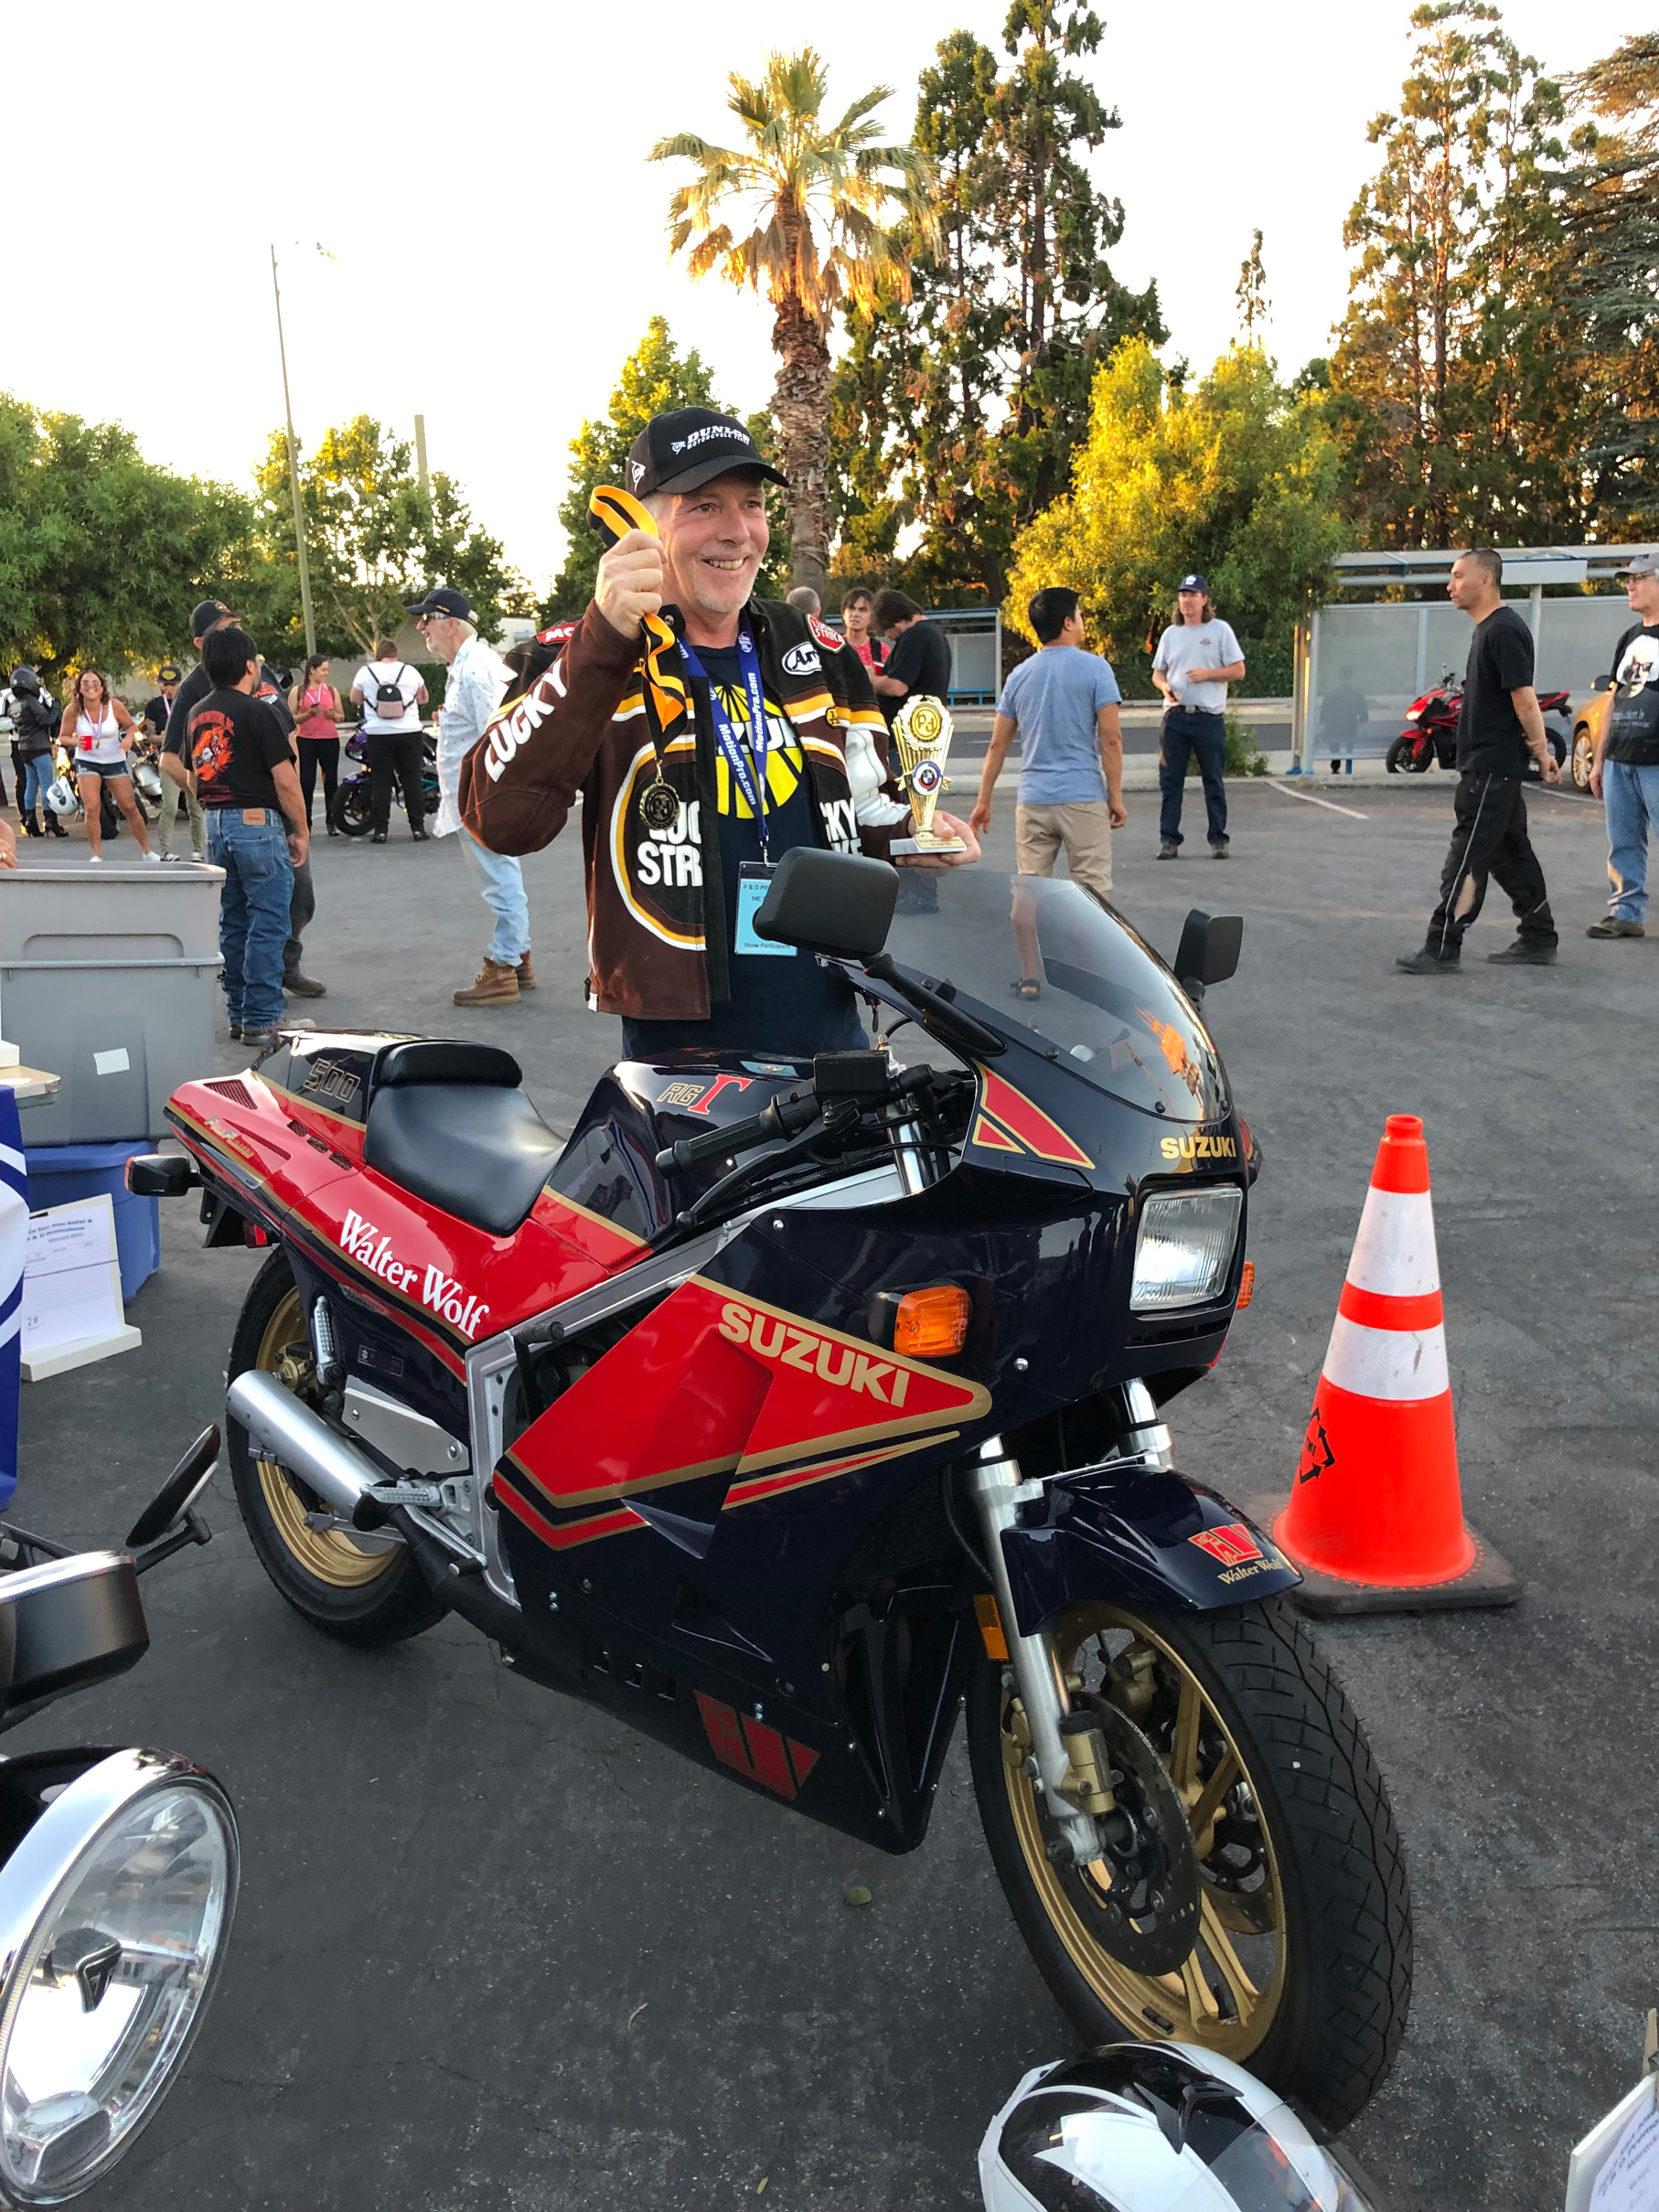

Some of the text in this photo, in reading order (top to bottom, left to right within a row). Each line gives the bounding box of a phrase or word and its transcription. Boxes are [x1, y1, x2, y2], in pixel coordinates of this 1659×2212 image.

[687, 425, 750, 443] DUNLOP
[687, 433, 732, 450] MOTORCYCLE
[484, 657, 568, 783] LUCKY
[752, 672, 763, 753] MotionPro.com
[717, 723, 757, 807] MotionPro.com
[303, 1057, 361, 1104] 500
[1160, 1136, 1236, 1159] SUZUKI
[339, 1208, 490, 1341] Walter Wolf
[718, 1302, 911, 1408] SUZUKI
[1217, 1557, 1284, 1585] Walter Wolf
